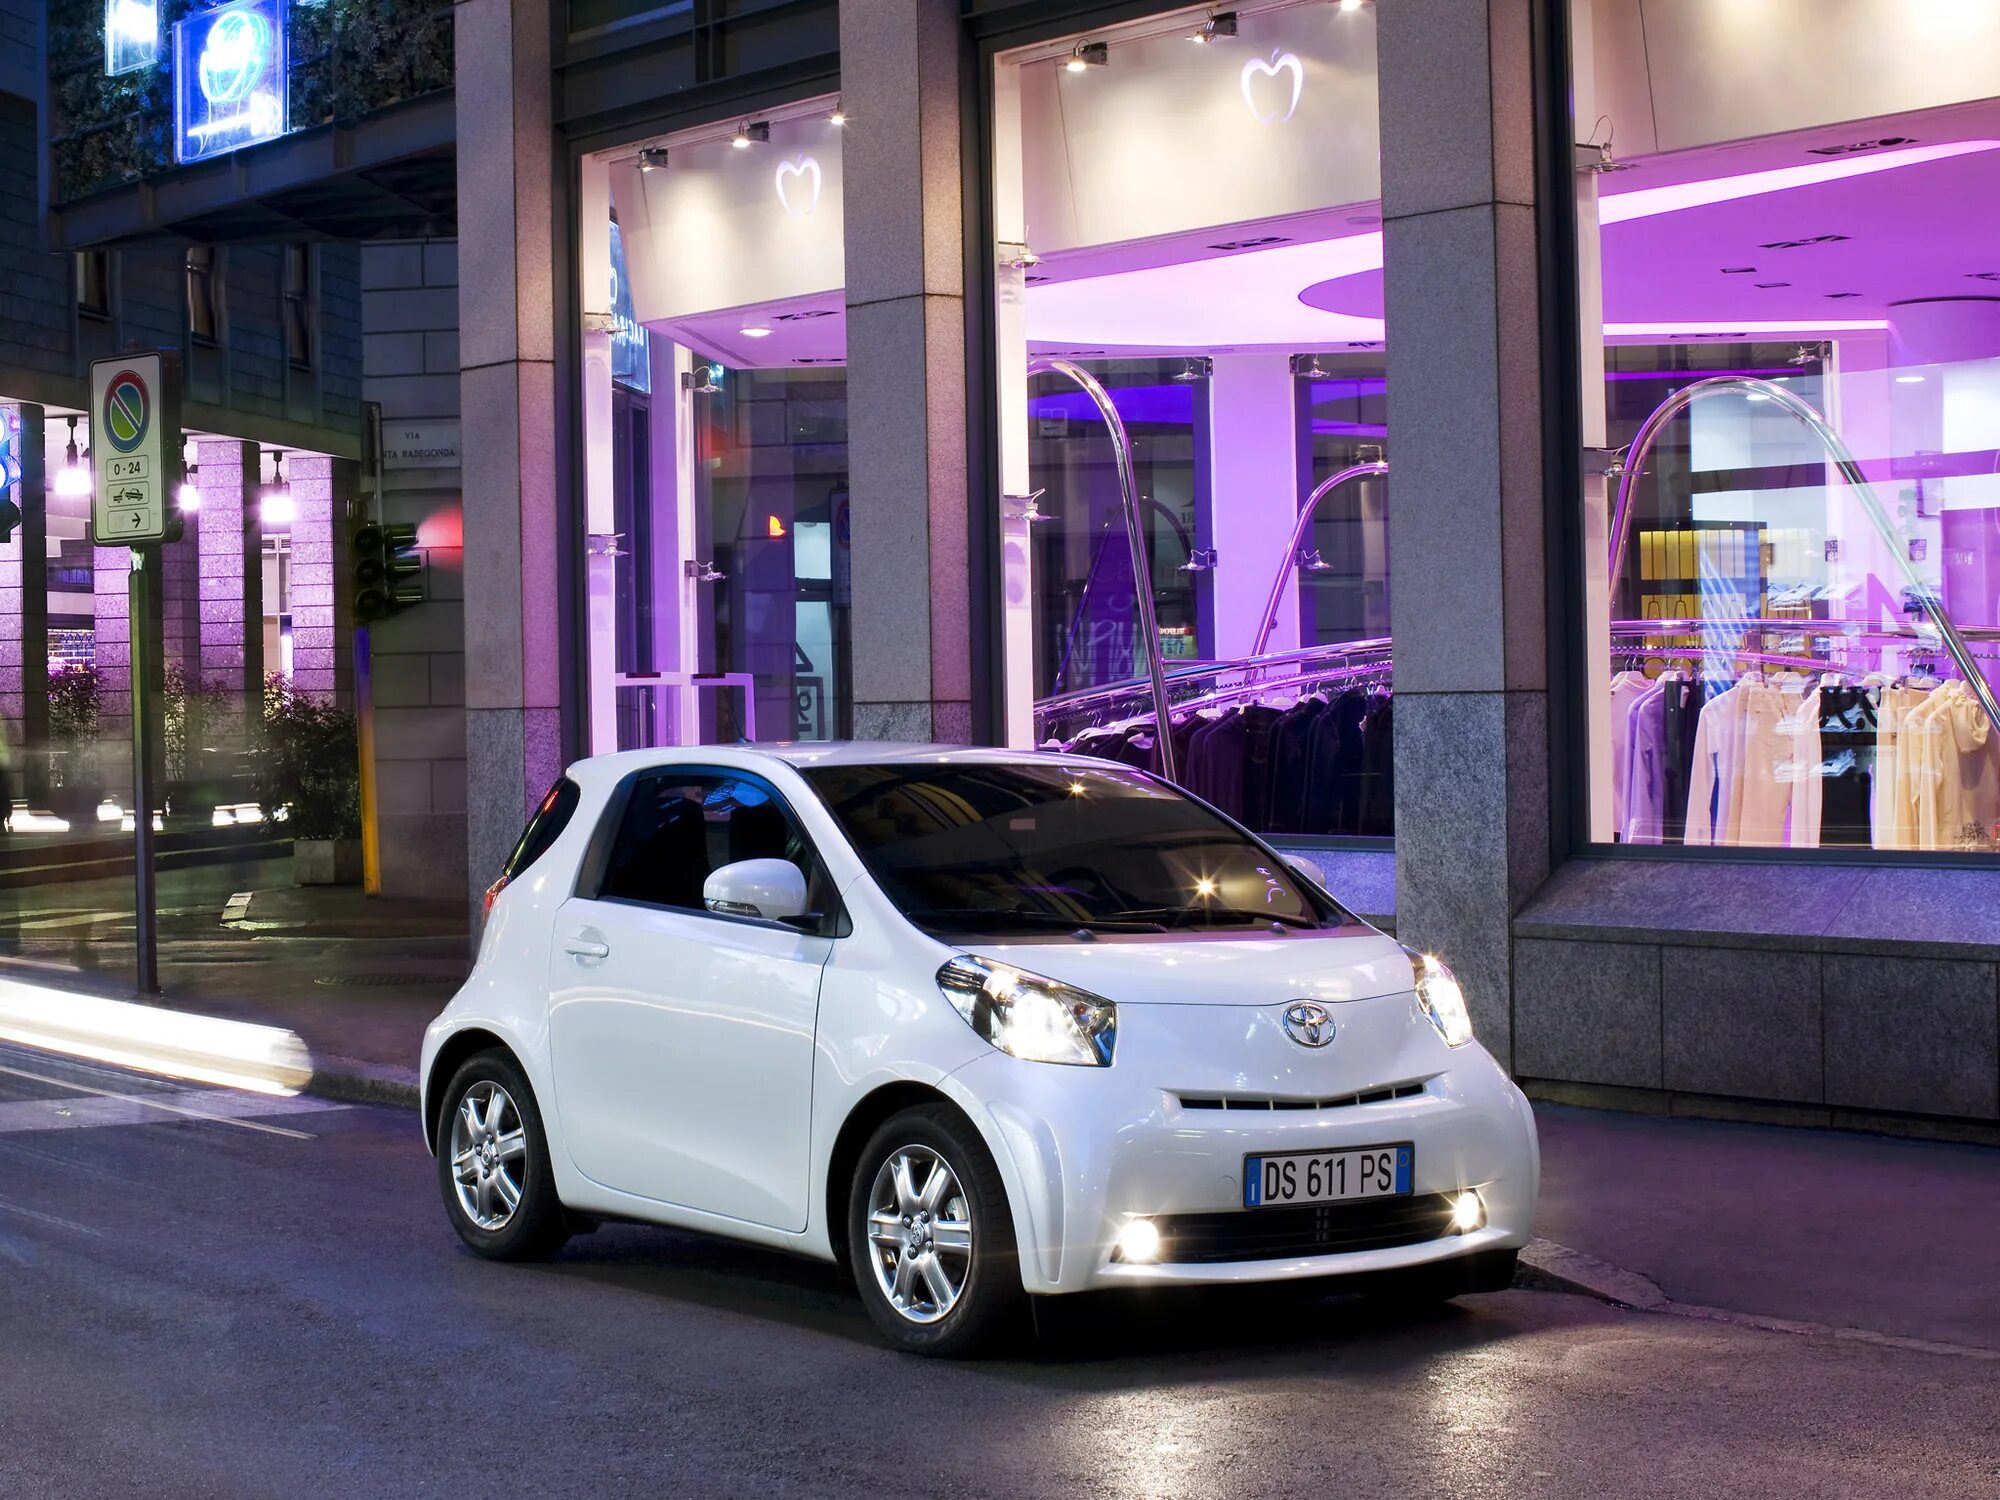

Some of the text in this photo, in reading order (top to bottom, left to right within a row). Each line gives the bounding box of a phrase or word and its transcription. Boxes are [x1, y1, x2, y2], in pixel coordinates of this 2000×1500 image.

[402, 448, 455, 458] RADEGONDA
[1265, 1153, 1392, 1200] DS 611 PS
